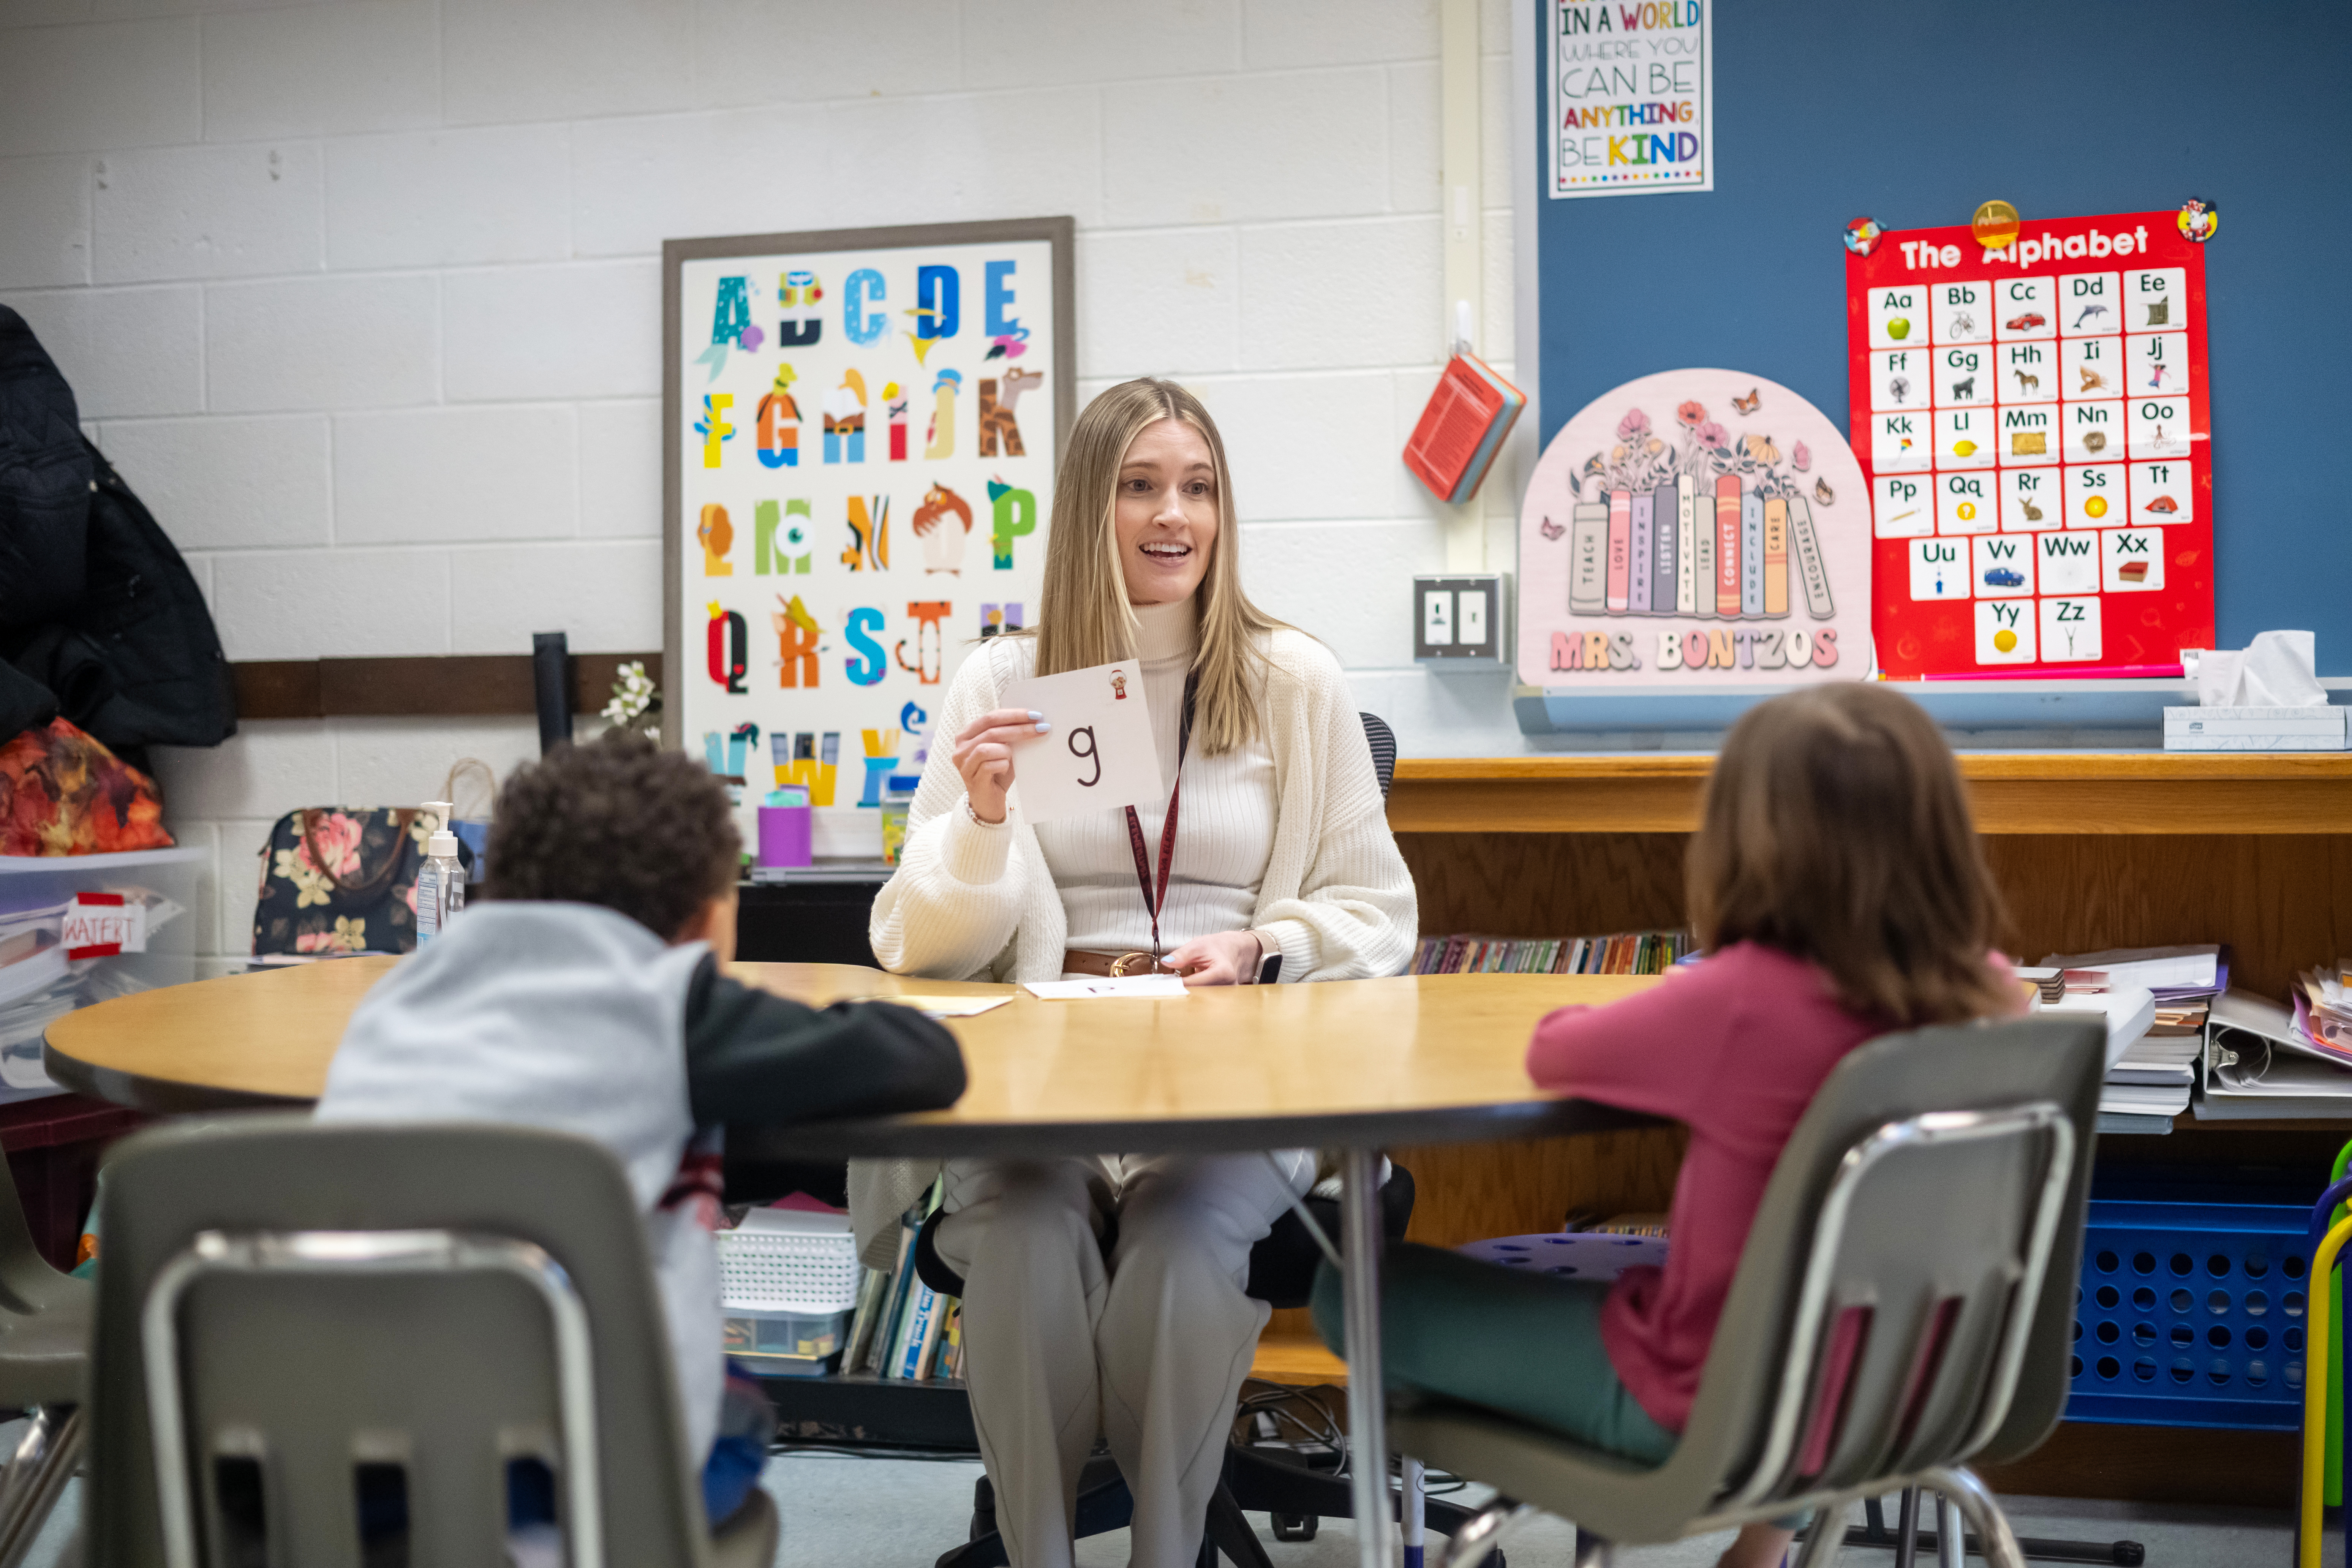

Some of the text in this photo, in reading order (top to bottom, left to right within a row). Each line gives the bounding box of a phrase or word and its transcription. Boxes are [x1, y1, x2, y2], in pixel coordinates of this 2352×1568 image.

[1562, 0, 1701, 35] IN A WORLD
[1563, 37, 1698, 62] WHERE YOU
[1562, 60, 1695, 98] CAN BE
[1563, 132, 1698, 167] BE KIND
[1901, 240, 1961, 270] The
[711, 277, 751, 350] A
[844, 269, 887, 347] C
[918, 265, 959, 339] D
[985, 260, 1017, 337] E
[1884, 274, 2165, 310] Aa Bb Cc Dd Ee
[1890, 336, 2162, 371] Ff Gg Hh Ii Jj
[704, 394, 733, 468] F
[756, 392, 799, 468] G
[979, 372, 1035, 458] K
[1887, 403, 2173, 435] Kk Ll Mm Nn Oo
[1890, 466, 2169, 502] Pp Qq Rr Ss Tt
[992, 487, 1036, 569] P
[1770, 518, 1780, 550] CARE
[1583, 534, 1594, 584] TEACH
[1614, 539, 1623, 569] LOVE
[1723, 523, 1735, 586] CONNECT
[1797, 521, 1824, 599] ENCOURAGE
[1924, 534, 2148, 562] Uu Vv Ww Xx
[1992, 602, 2085, 627] Yy Zz
[707, 610, 748, 694] Q
[780, 612, 819, 688] R
[845, 607, 887, 686] S
[1550, 628, 1838, 670] MRS. BONTZOS
[770, 732, 840, 806] W
[1069, 726, 1101, 787] g
